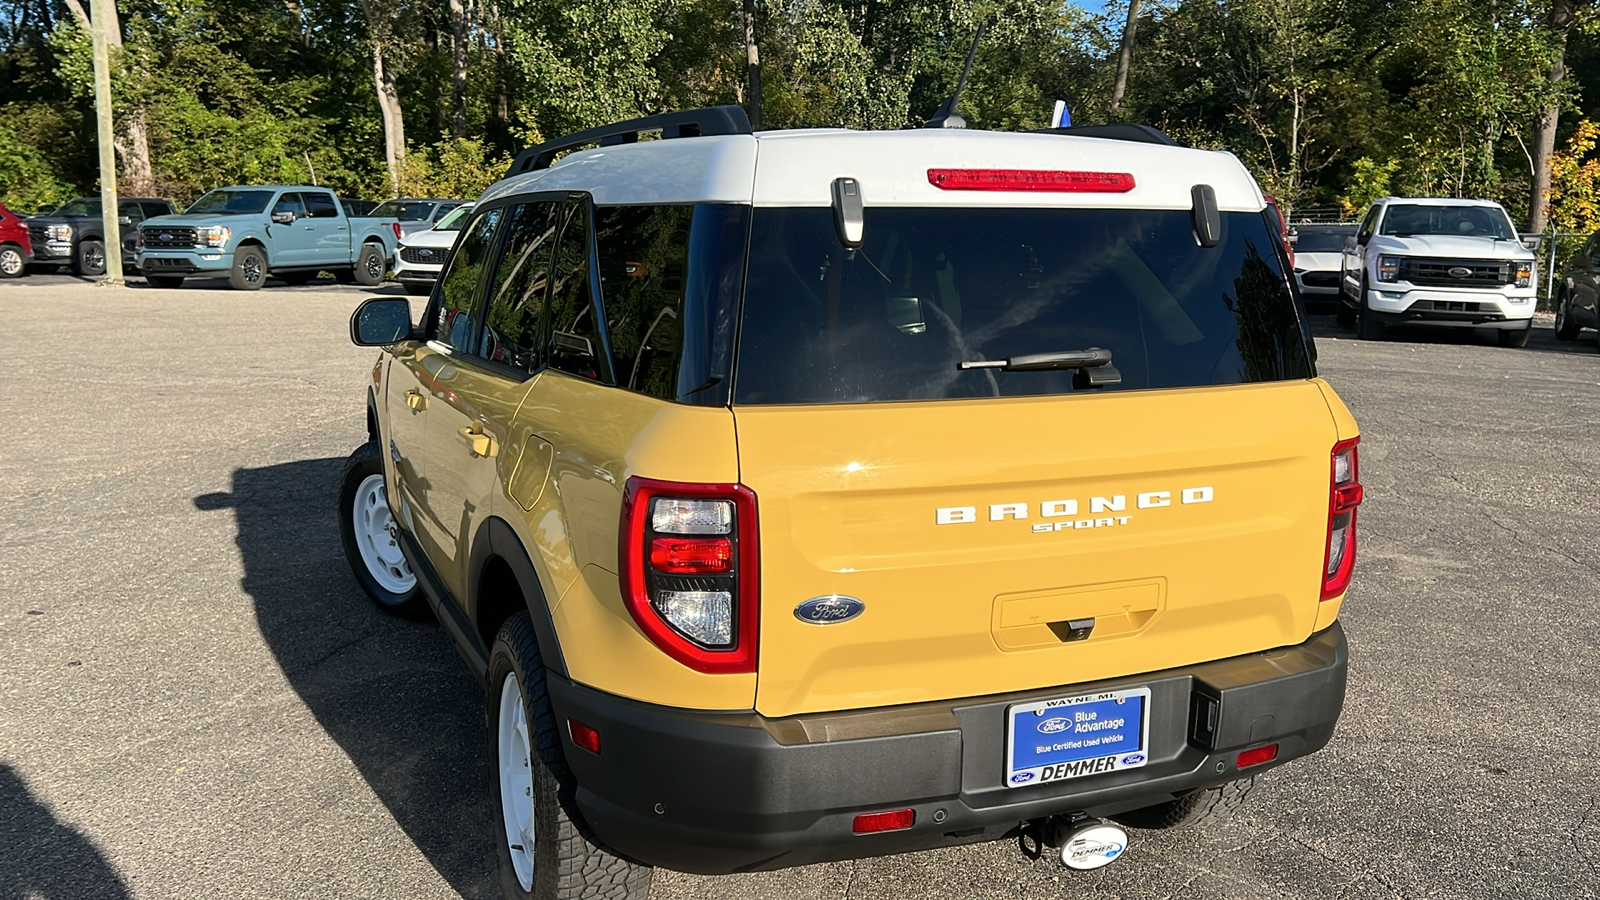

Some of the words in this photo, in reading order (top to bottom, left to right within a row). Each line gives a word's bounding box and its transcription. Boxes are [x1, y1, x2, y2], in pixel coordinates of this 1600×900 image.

[936, 486, 1214, 525] BRONCO
[1031, 515, 1133, 533] SPORT
[811, 602, 850, 619] Ford
[1075, 711, 1097, 722] Blue
[1043, 719, 1066, 732] Ford
[1074, 718, 1125, 733] Advantage
[1036, 745, 1052, 754] Blue
[1052, 741, 1082, 751] Certified
[1083, 738, 1100, 747] Used
[1101, 734, 1124, 744] Vehicle
[1040, 756, 1117, 781] DEMMER
